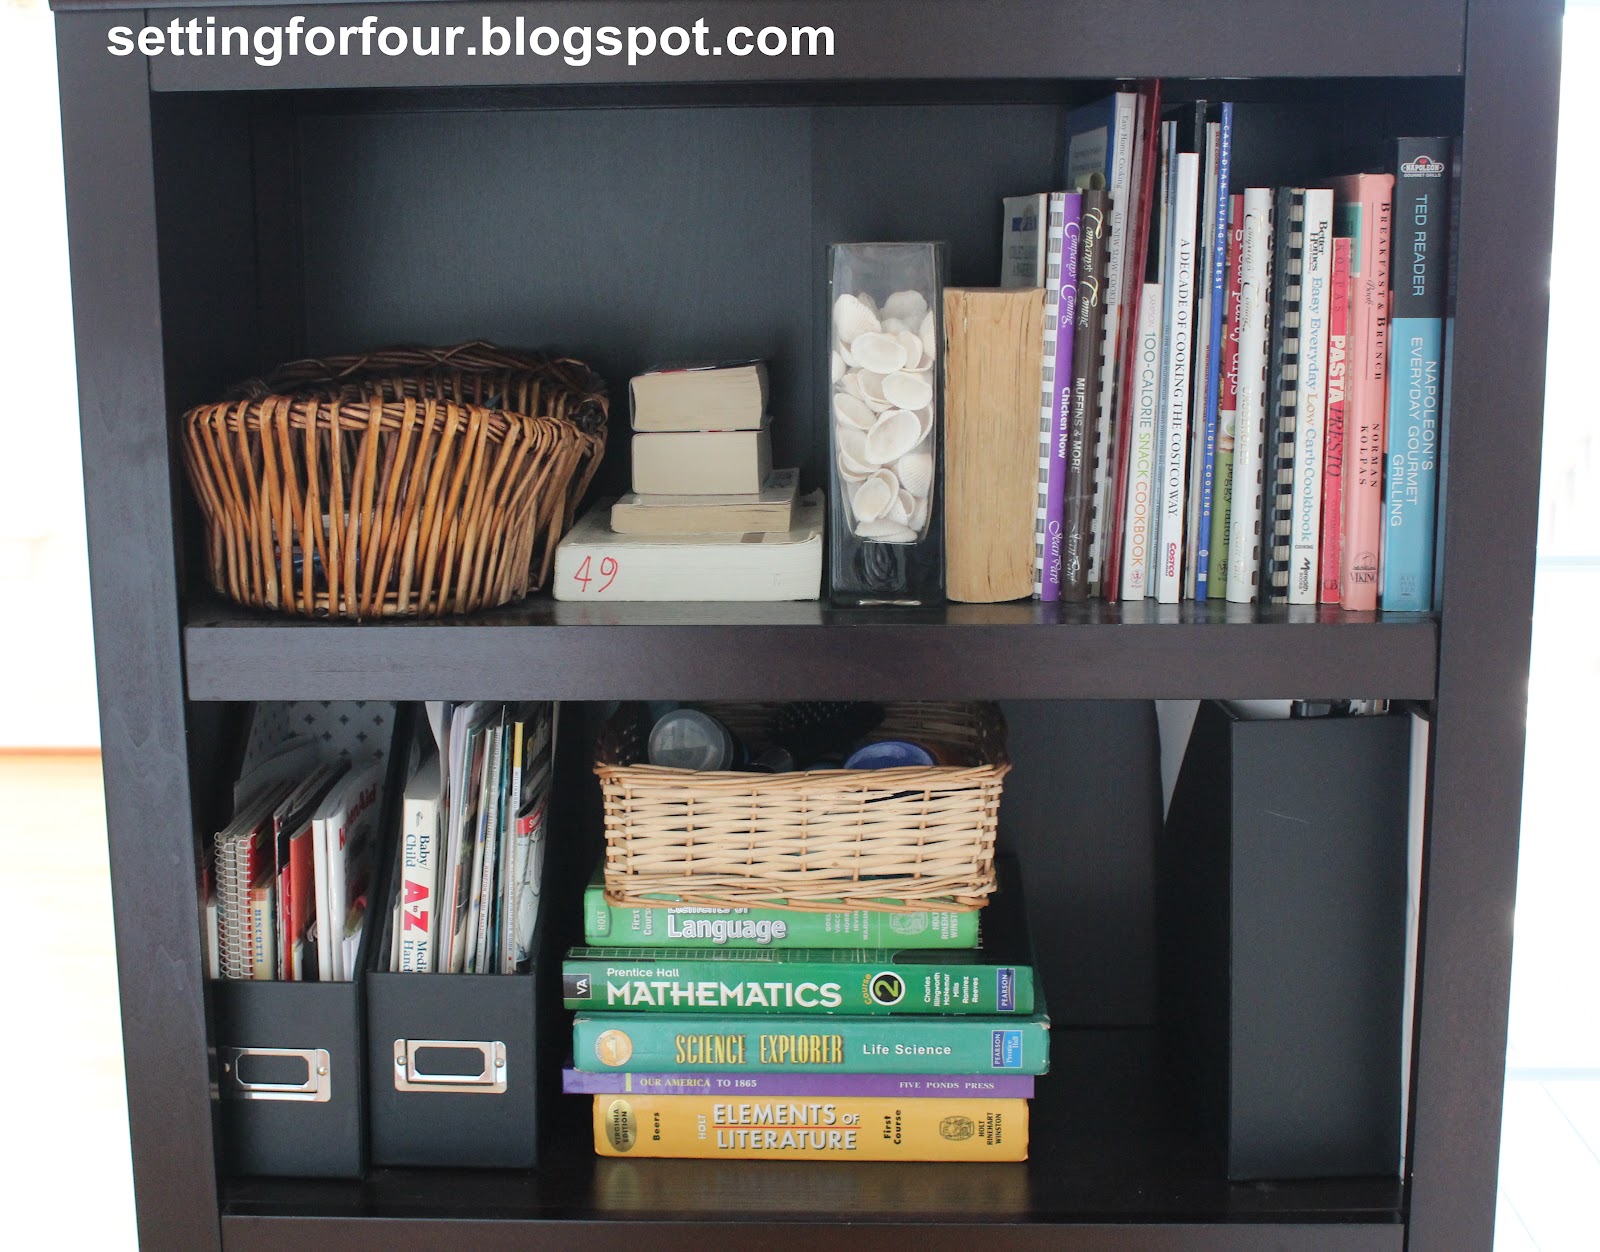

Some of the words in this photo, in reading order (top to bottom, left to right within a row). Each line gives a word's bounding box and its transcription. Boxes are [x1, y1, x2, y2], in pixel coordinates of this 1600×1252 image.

[1120, 115, 1128, 131] Easy
[1119, 134, 1127, 155] Home
[1221, 125, 1229, 188] CANADIAN
[1117, 158, 1126, 189] Cooking
[1415, 194, 1428, 226] TED
[1064, 217, 1081, 279] Company's
[1181, 239, 1190, 248] A
[1309, 232, 1318, 271] Homes
[1318, 221, 1328, 255] Better
[1377, 202, 1390, 297] BREAKFAST
[1111, 249, 1119, 271] SLOW
[1412, 232, 1426, 296] READER
[1109, 274, 1117, 306] COOKER
[1178, 252, 1190, 307] DECADE
[1309, 277, 1322, 314] Easy
[1335, 244, 1345, 313] KOLPAS
[1364, 279, 1374, 305] Book
[1060, 279, 1077, 325] Coming
[1177, 310, 1187, 329] OF
[1173, 332, 1186, 398] COOKING
[1306, 318, 1321, 390] Everyday
[1374, 317, 1386, 381] BRUNCH
[1140, 332, 1157, 428] 100-CALORIE
[1329, 335, 1346, 404] PASTA
[1408, 337, 1423, 421] EVERYDAY
[1060, 386, 1071, 431] Chicken
[1074, 377, 1085, 426] MUFFINS
[1172, 402, 1183, 429] THE
[1306, 393, 1318, 425] Low
[1422, 360, 1437, 471] NAPOLEON'S
[1058, 434, 1068, 458] Now
[1074, 429, 1081, 437] &
[1207, 422, 1215, 457] LIGHT
[1304, 428, 1317, 466] Carb
[1327, 407, 1344, 477] PRESTO
[1071, 440, 1081, 473] MORE
[1137, 433, 1150, 478] SNACK
[1169, 433, 1181, 487] COSTCO
[1358, 425, 1368, 486] KOLPAS
[1370, 423, 1379, 488] NORMAN
[1405, 425, 1419, 505] GOURMET
[1203, 464, 1212, 517] COOKING
[1301, 468, 1315, 542] Cookbook
[1390, 454, 1405, 527] GRILLING
[1049, 520, 1063, 556] Jean
[1132, 481, 1147, 566] COOKBOOK
[574, 555, 618, 593] 49
[1301, 557, 1311, 592] Meredith
[1350, 572, 1377, 584] VIKING
[405, 833, 417, 868] Child
[417, 835, 431, 871] Baby/
[404, 879, 429, 904] A
[254, 909, 263, 963] BISCOTTI
[404, 910, 429, 933] Z
[597, 911, 606, 931] HOLT
[632, 909, 640, 931] First
[644, 908, 653, 936] Cours
[667, 914, 787, 944] Language
[932, 912, 940, 931] HOLT
[941, 911, 949, 940] RINEHA
[950, 912, 958, 939] WINST
[575, 977, 589, 996] VA
[606, 968, 653, 978] Prentice
[656, 968, 680, 977] Hall
[874, 980, 899, 998] 2
[933, 972, 941, 1007] Illingworth
[606, 980, 843, 1008] MATHEMATICS
[675, 1034, 747, 1065] SCIENCE
[759, 1034, 843, 1065] EXPLORER
[863, 1044, 890, 1055] Life
[895, 1044, 952, 1055] Science
[639, 1078, 662, 1087] OUR
[664, 1079, 711, 1087] AMERICA
[717, 1079, 731, 1087] TO
[735, 1079, 757, 1088] 1865
[697, 1114, 707, 1139] HOLT
[713, 1103, 837, 1125] ELEMENTS
[841, 1113, 860, 1125] OF
[884, 1115, 892, 1139] First
[894, 1109, 902, 1145] Course
[717, 1130, 858, 1150] LITERATURE
